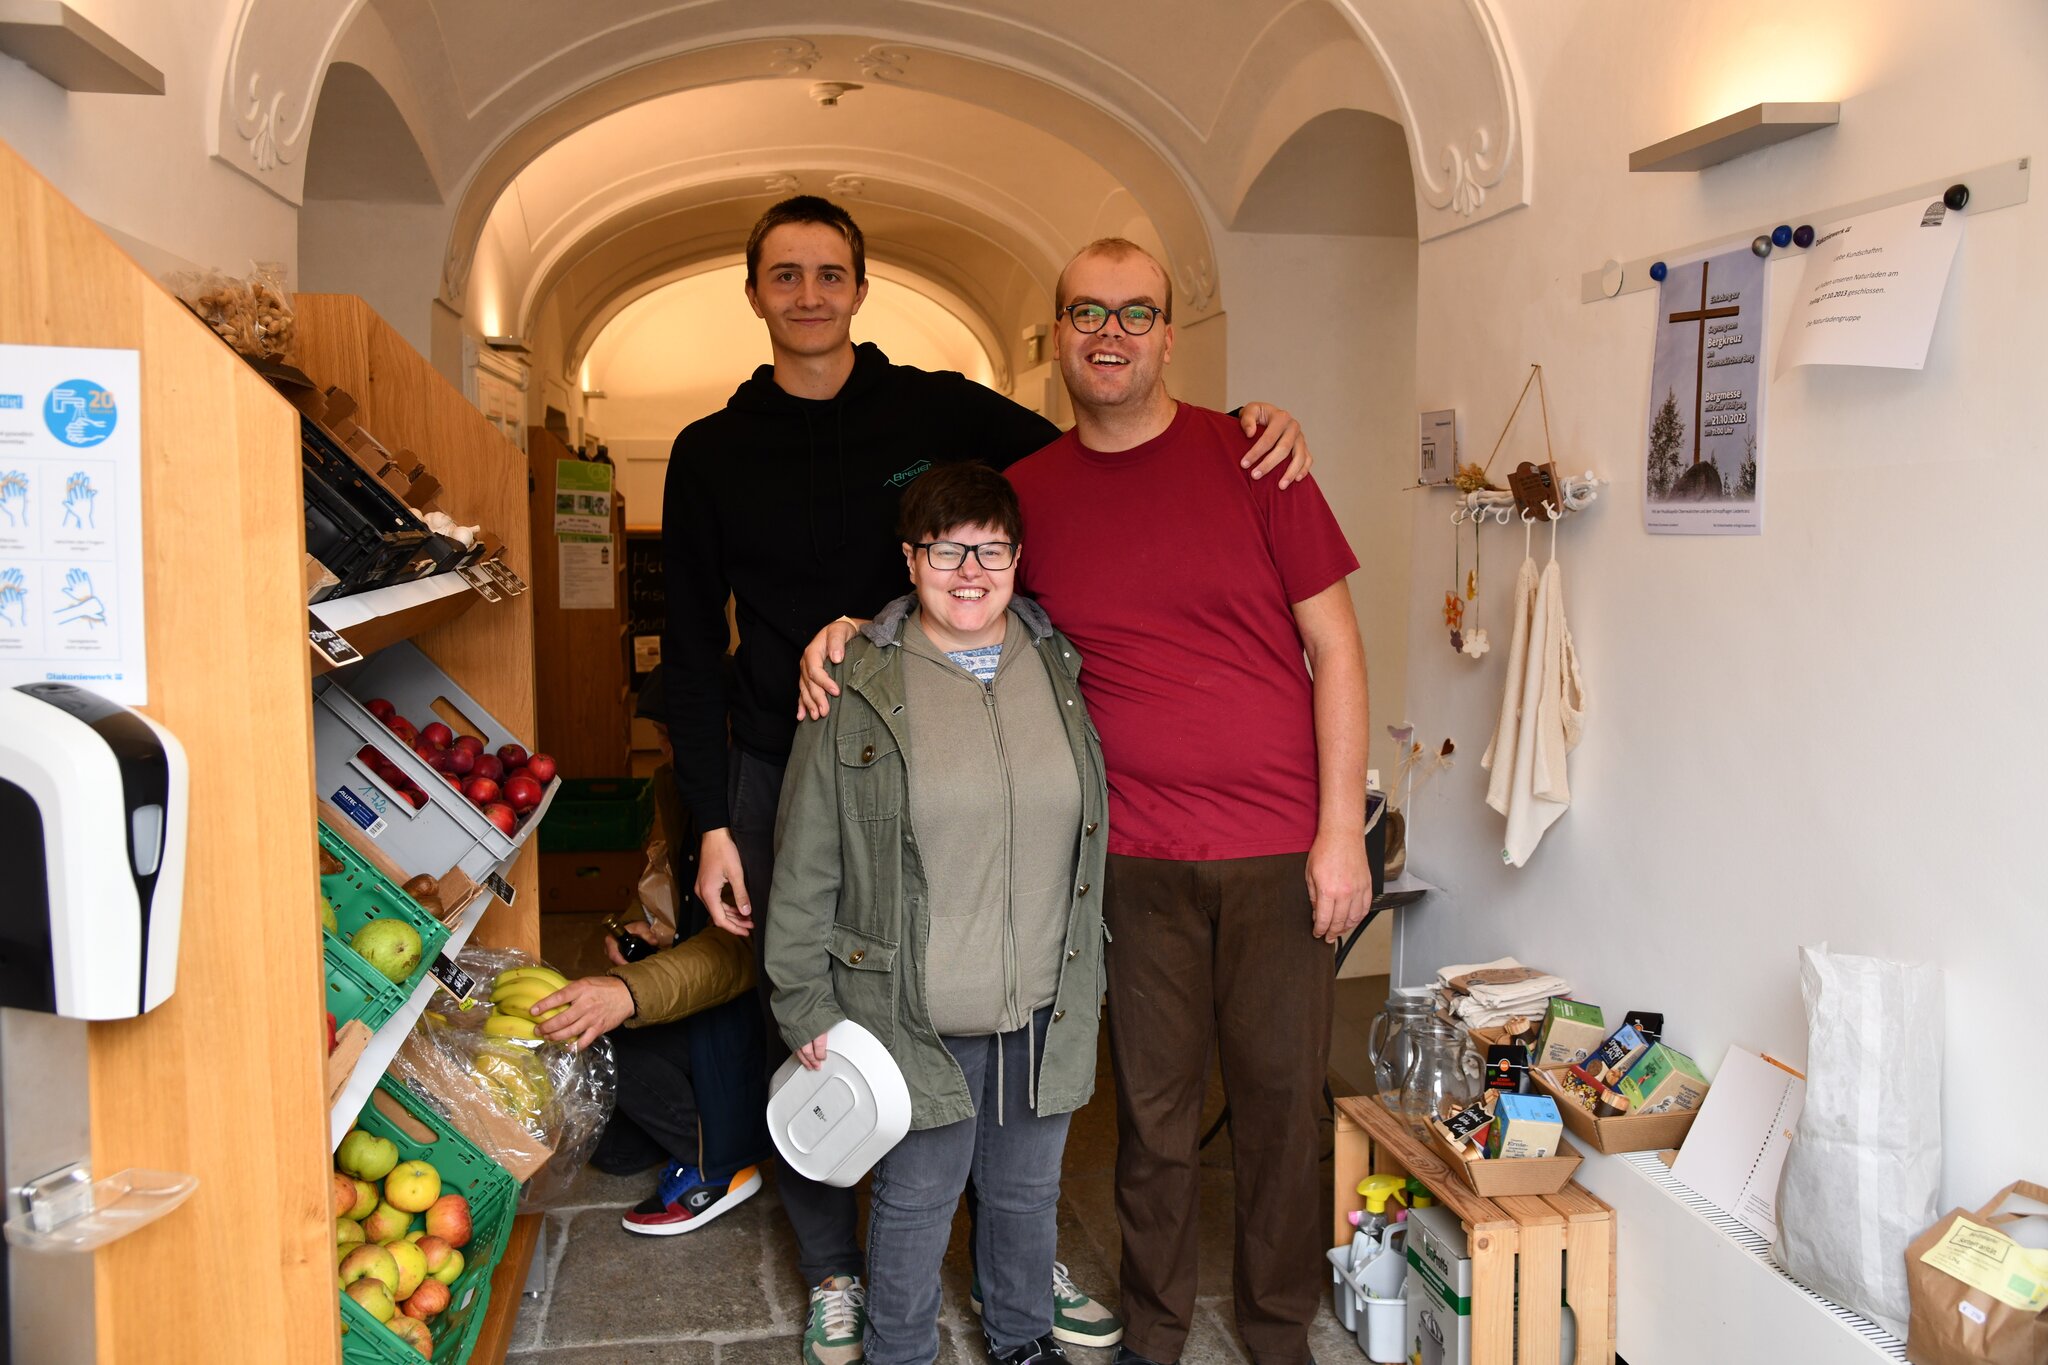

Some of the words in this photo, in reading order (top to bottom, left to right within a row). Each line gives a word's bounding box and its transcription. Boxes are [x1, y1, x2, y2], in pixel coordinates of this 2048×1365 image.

[1854, 272, 1887, 281] Naturladen
[1847, 287, 1886, 298] geschlossen.
[1813, 315, 1862, 326] Naturladengruppe
[1707, 334, 1742, 349] Bergkreuz
[89, 390, 113, 408] 20
[1705, 390, 1742, 403] Bergmesse
[1712, 413, 1747, 426] 21.10.2023
[1725, 426, 1734, 435] Uhr
[893, 463, 932, 482] Breuer
[47, 672, 113, 681] Diakoniewerk
[338, 790, 357, 807] ALUTEC
